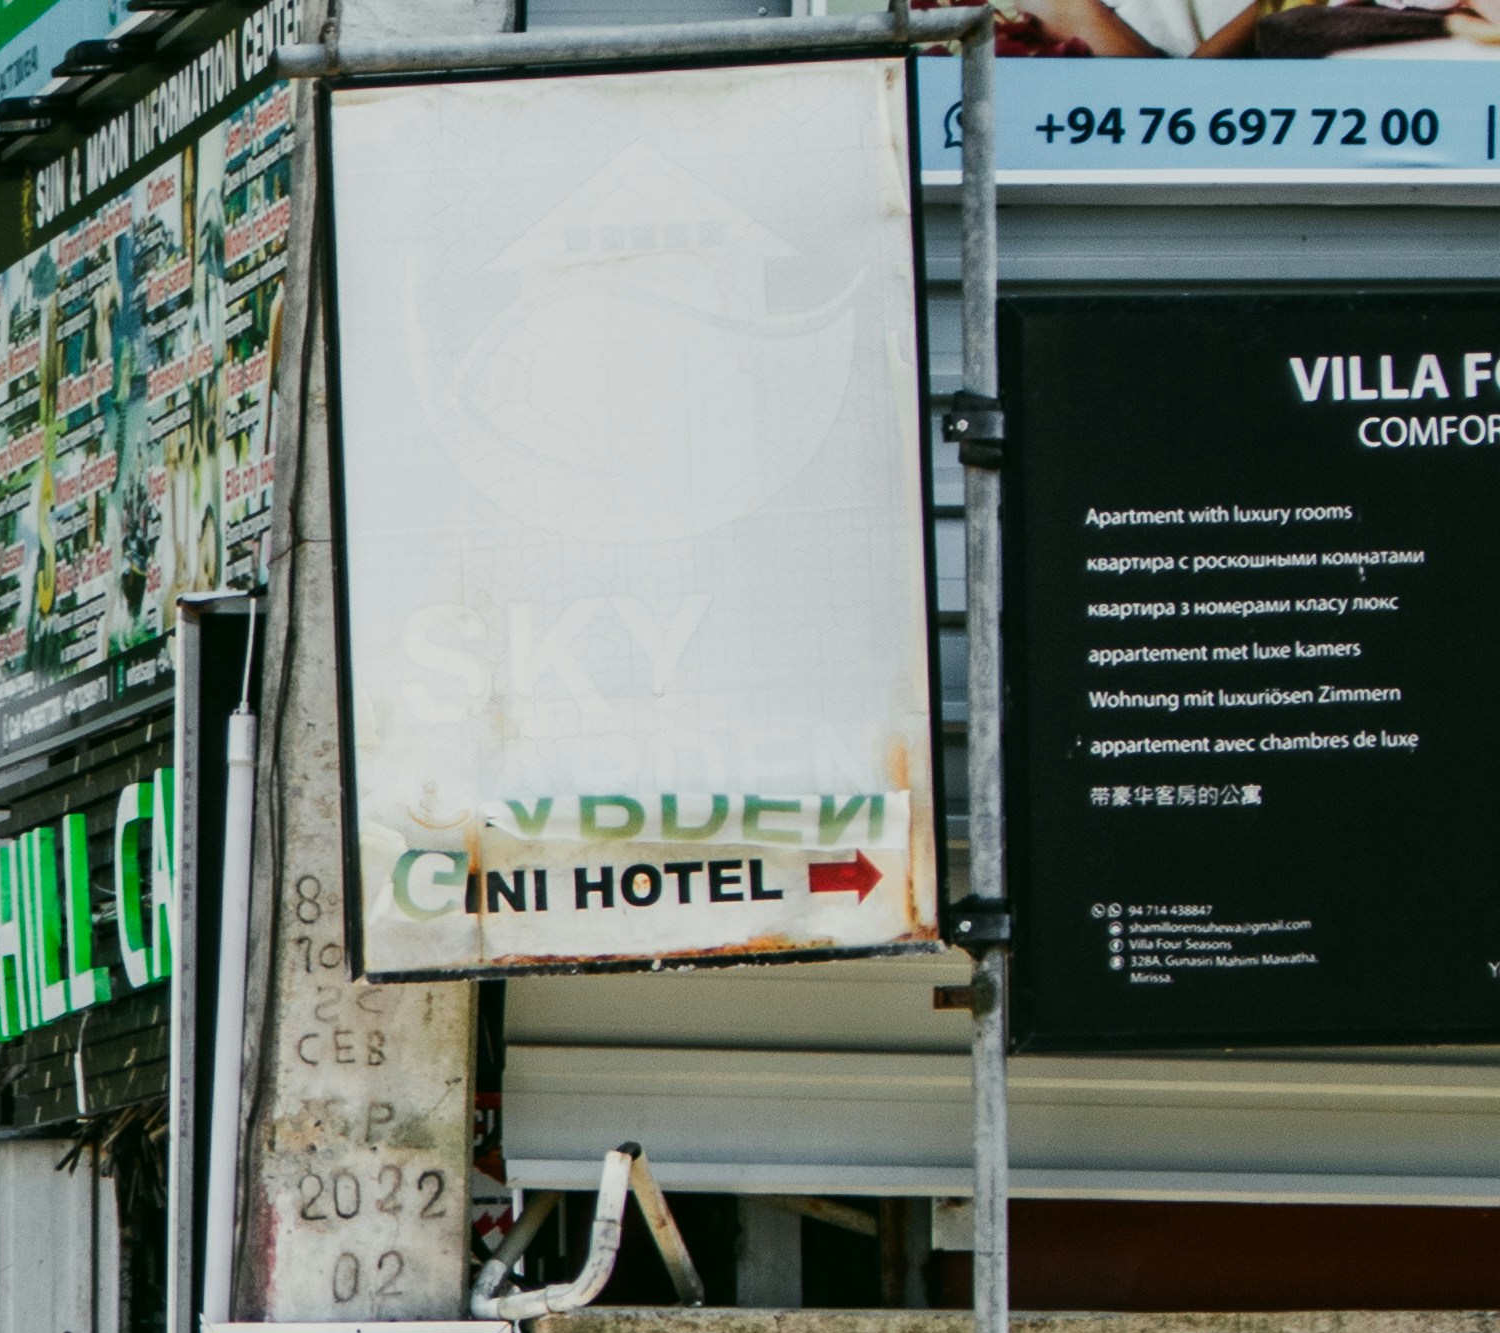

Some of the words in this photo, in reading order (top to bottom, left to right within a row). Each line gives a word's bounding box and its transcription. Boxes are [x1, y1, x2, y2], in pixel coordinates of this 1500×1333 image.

[36, 156, 65, 228] SUN
[71, 148, 82, 205] &
[86, 112, 129, 195] MOON
[134, 29, 237, 161] INFORMATION
[1035, 108, 1126, 145] +94
[1139, 107, 1195, 145] 76
[1209, 107, 1296, 145] 697
[1311, 108, 1366, 145] 72
[1380, 108, 1439, 145] 00
[1289, 353, 1450, 401] VILLA
[1464, 352, 1500, 398] F
[1085, 507, 1185, 529] Apartment
[1188, 506, 1229, 524] with
[1234, 505, 1291, 526] luxury
[1295, 505, 1352, 521] rooms
[1087, 555, 1175, 574] квартира
[1179, 557, 1189, 570] с
[1193, 553, 1317, 573] роскошными
[1321, 550, 1425, 566] комнатами
[1087, 601, 1176, 620] квартира
[1180, 602, 1190, 616] з
[1194, 599, 1291, 618] номерами
[1295, 597, 1348, 616] класу
[1352, 595, 1400, 611] люкс
[1088, 646, 1208, 667] appartement
[1212, 645, 1249, 661] met
[1252, 642, 1292, 659] luxe
[1295, 640, 1362, 659] kamers
[1088, 690, 1180, 713] Wohnung
[1184, 689, 1214, 707] mit
[1218, 687, 1314, 706] luxuriösen
[1318, 685, 1401, 704] Zimmern
[1090, 736, 1210, 758] appartement
[1214, 737, 1256, 754] avec
[1259, 731, 1350, 752] chambres
[1353, 730, 1377, 748] de
[1380, 730, 1420, 748] luxe
[1089, 784, 1263, 807] 带豪华客房的公寓
[574, 858, 785, 911] HOTEL
[1128, 904, 1143, 917] 94
[1146, 904, 1167, 917] 714
[1128, 938, 1154, 951] Villa
[1156, 938, 1182, 951] Four
[1185, 938, 1233, 951] Seasons
